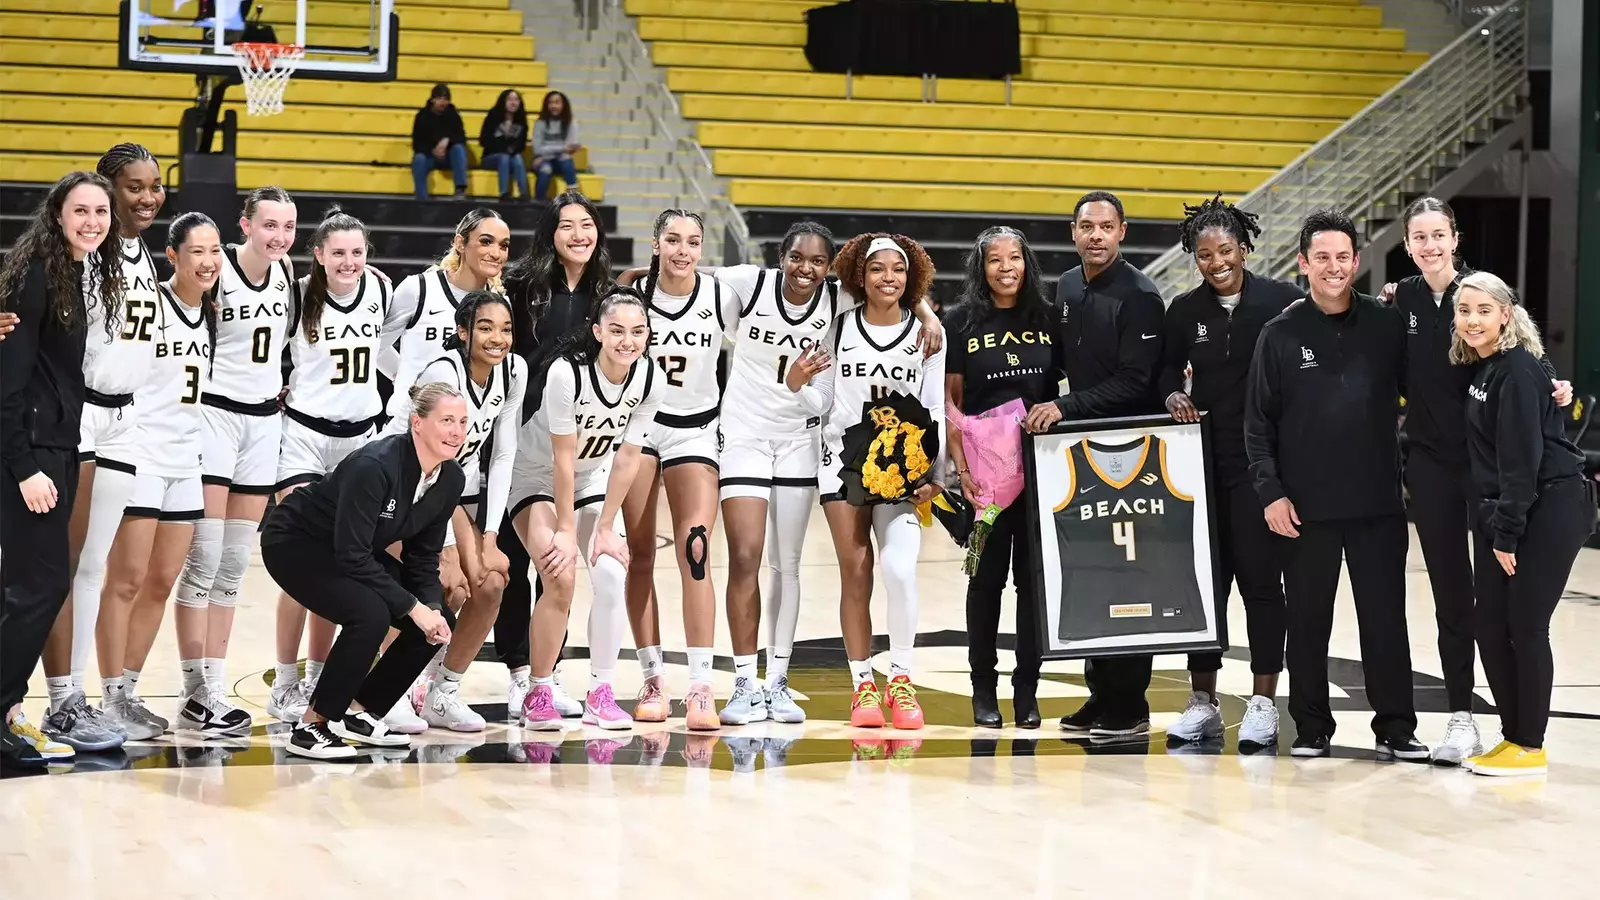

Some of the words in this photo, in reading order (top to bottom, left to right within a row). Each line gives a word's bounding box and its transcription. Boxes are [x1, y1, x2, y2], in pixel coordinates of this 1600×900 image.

[121, 300, 156, 341] 52
[155, 341, 209, 358] BEAC
[252, 326, 271, 363] 0
[650, 331, 712, 347] EACH
[967, 331, 1052, 354] BEACH
[1006, 352, 1020, 366] LB
[1301, 346, 1315, 361] LB
[330, 346, 370, 385] 30
[841, 363, 917, 383] BEACH
[987, 367, 1043, 380] BASKETBALL
[181, 365, 199, 404] 3
[577, 435, 616, 459] 10
[1080, 498, 1165, 520] BEACH
[1112, 520, 1136, 562] 4
